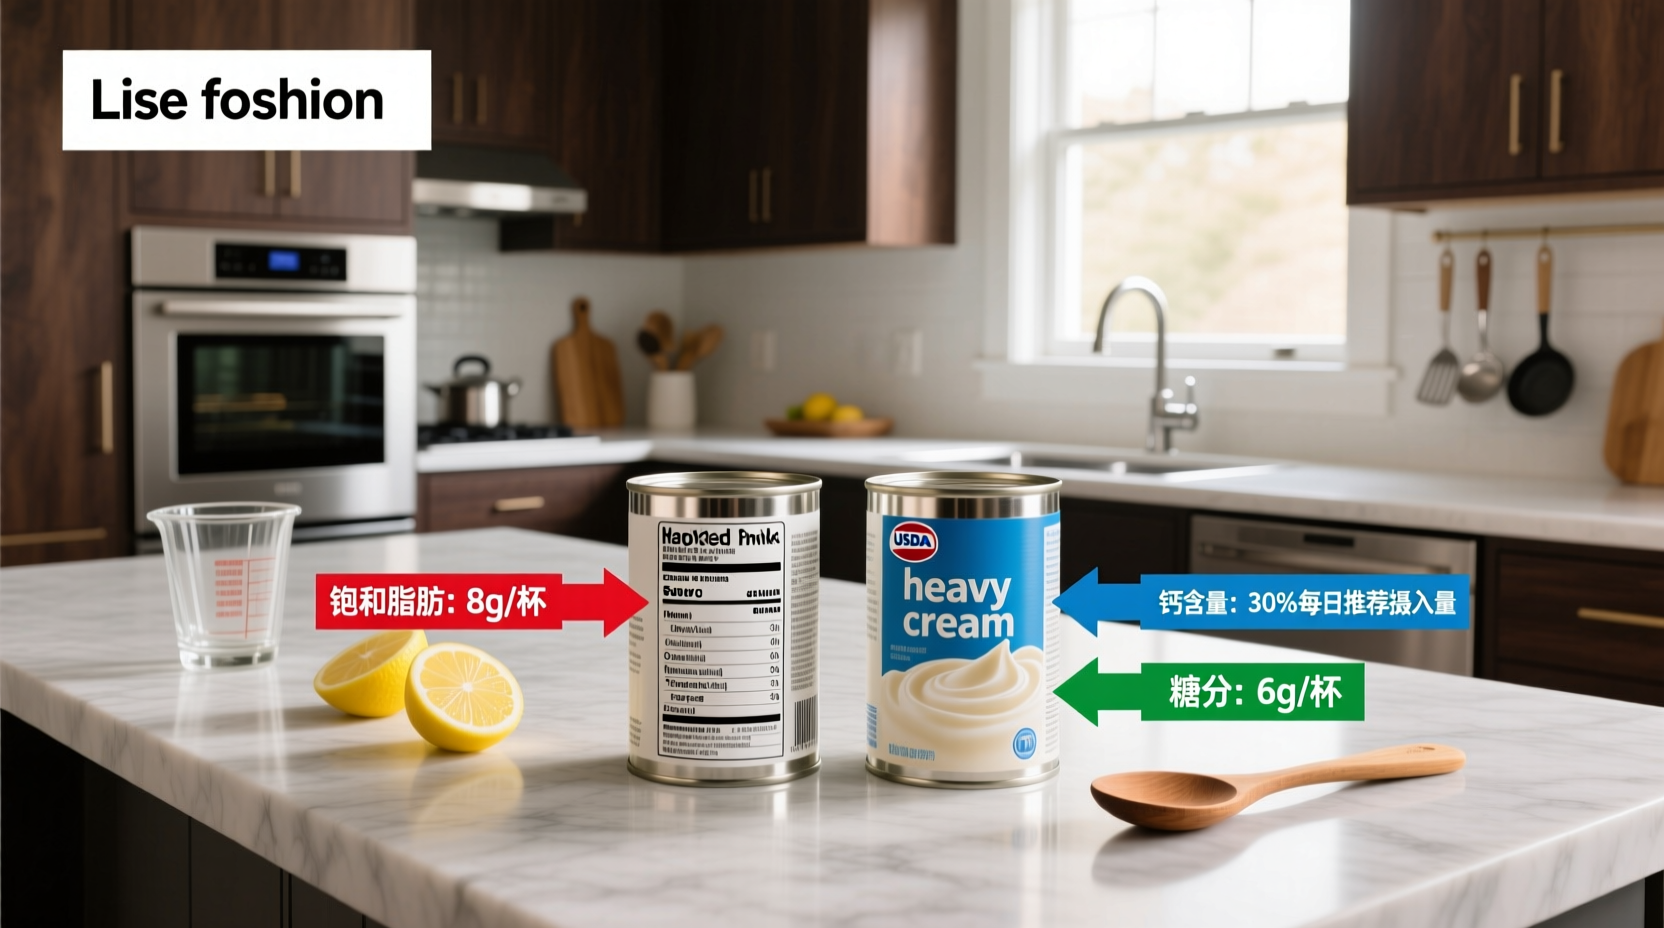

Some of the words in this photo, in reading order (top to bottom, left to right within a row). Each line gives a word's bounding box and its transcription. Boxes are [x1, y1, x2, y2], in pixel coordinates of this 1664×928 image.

[894, 533, 932, 547] USDA
[904, 566, 1012, 611] heavy
[903, 611, 1014, 638] cream
